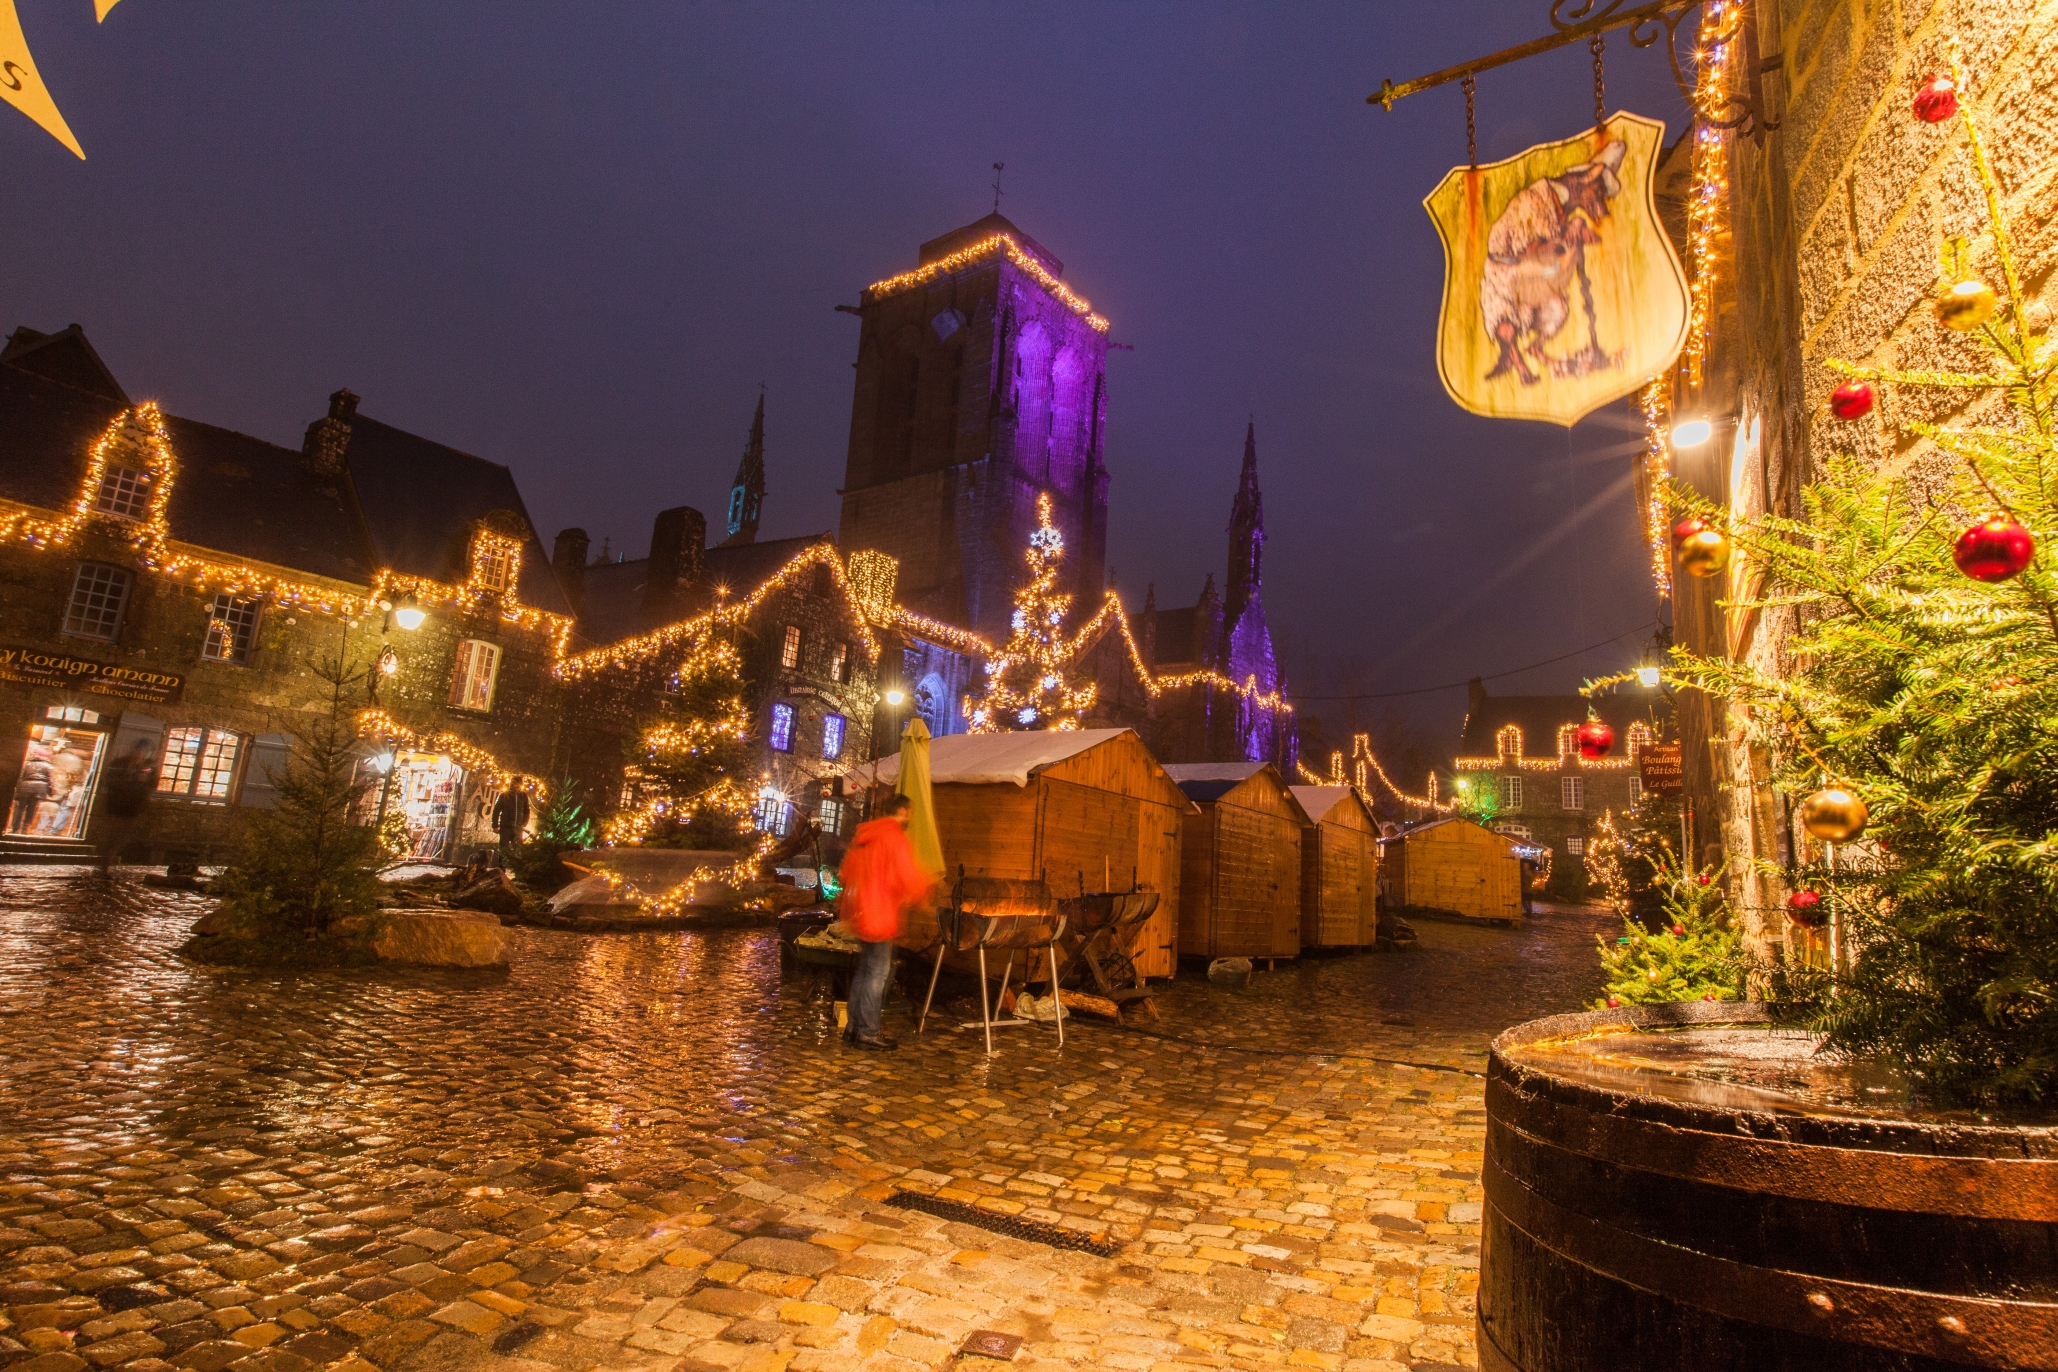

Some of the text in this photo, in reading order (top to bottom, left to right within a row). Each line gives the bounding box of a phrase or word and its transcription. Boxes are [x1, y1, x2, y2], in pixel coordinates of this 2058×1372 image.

[20, 649, 98, 675] kouign
[101, 666, 179, 687] amann
[91, 685, 166, 703] Chocolatier
[1653, 745, 1679, 753] Artisan
[1649, 780, 1660, 788] Le
